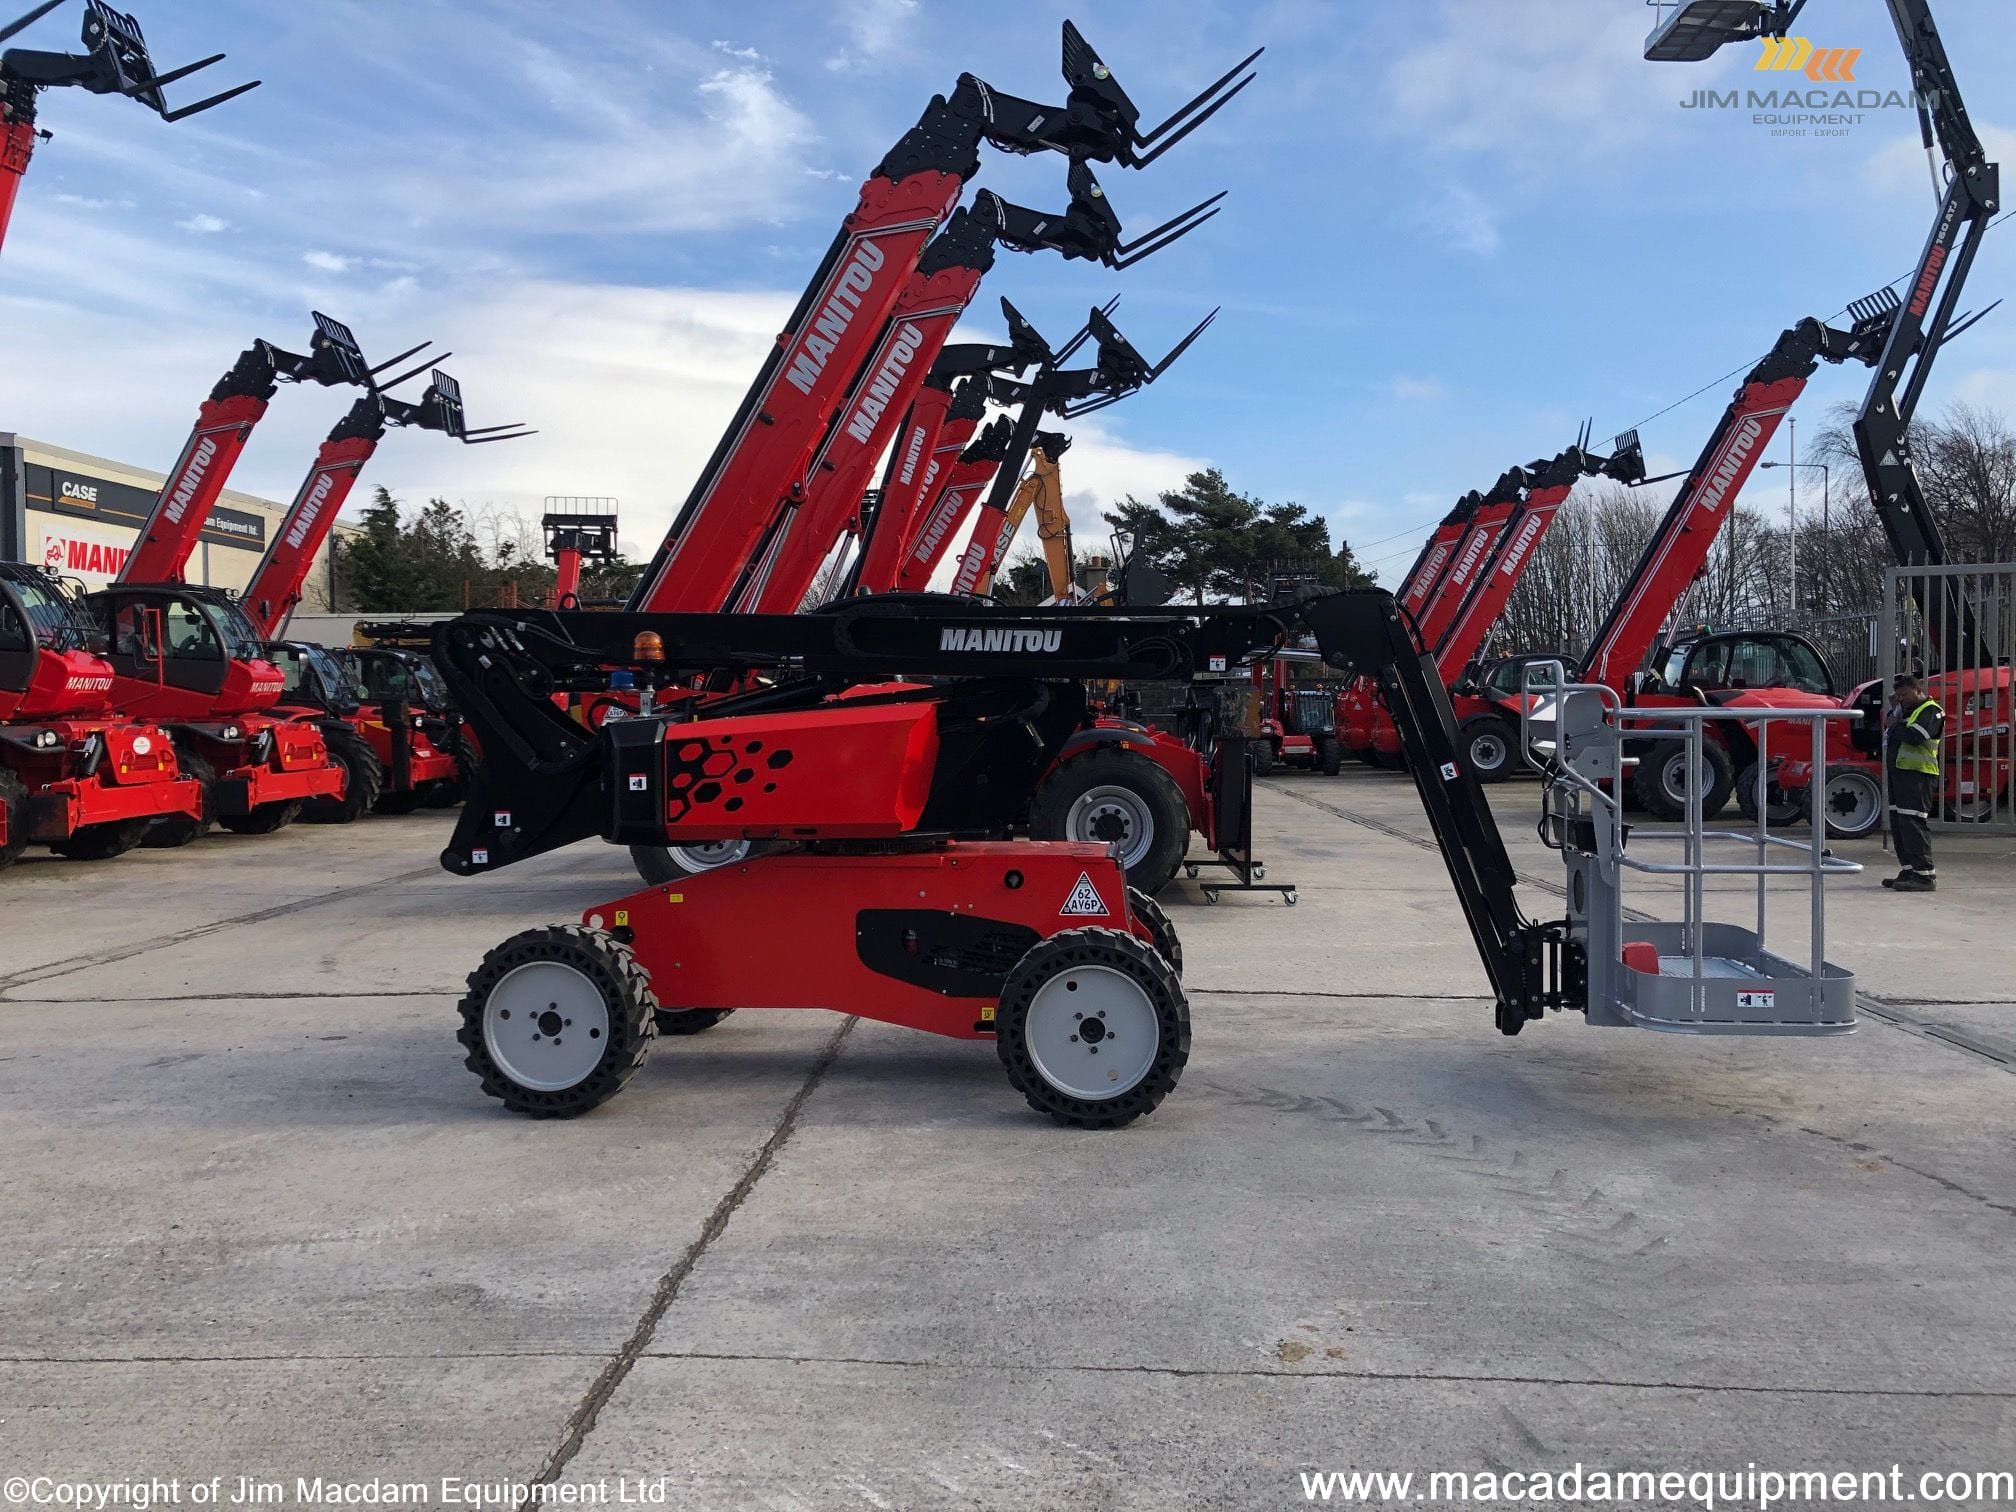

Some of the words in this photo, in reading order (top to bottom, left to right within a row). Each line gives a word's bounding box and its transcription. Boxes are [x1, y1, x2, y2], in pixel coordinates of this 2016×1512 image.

[1909, 244, 1946, 317] MANITOU
[1945, 200, 1958, 222] ATJ
[785, 240, 885, 396] MANITOU
[846, 321, 924, 445] MANITOU
[164, 437, 217, 524] MANITOU
[900, 426, 926, 486] MANITOU
[1700, 418, 1762, 512] MANITOU
[62, 482, 97, 501] CASE
[286, 473, 334, 549] MANITOU
[216, 517, 248, 533] Equipment
[915, 491, 963, 564] MANITOU
[992, 521, 1015, 564] ASE
[1501, 514, 1541, 575] MANITOU
[67, 540, 131, 575] MANI
[952, 541, 986, 598] NITOU
[1414, 546, 1447, 598] MANITOU
[1453, 529, 1489, 585] MANITOU
[940, 628, 1062, 652] MANITOU
[65, 676, 112, 690] MANITOU
[250, 682, 284, 693] MANITOU
[1071, 900, 1098, 910] AY6P
[1078, 889, 1091, 899] 62
